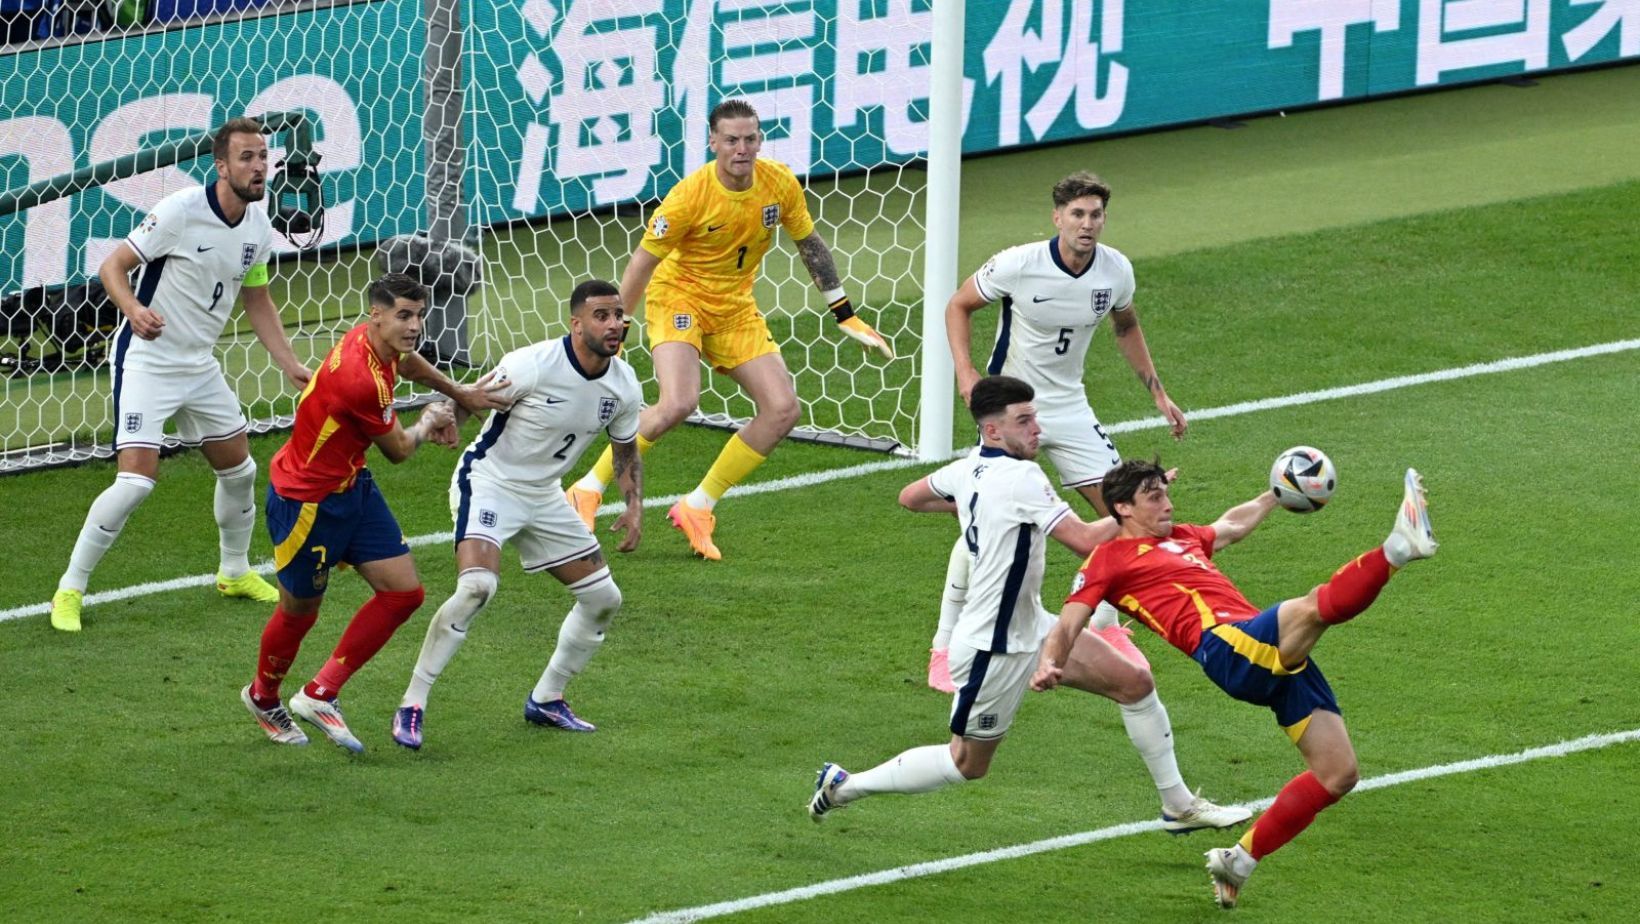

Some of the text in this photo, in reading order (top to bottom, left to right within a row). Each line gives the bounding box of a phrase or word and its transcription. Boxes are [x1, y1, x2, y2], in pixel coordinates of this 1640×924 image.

[512, 0, 1130, 214] 海信电视
[736, 246, 748, 270] 1
[208, 281, 224, 312] 9
[1055, 327, 1074, 356] 5
[553, 433, 576, 460] 2
[311, 545, 327, 570] 7
